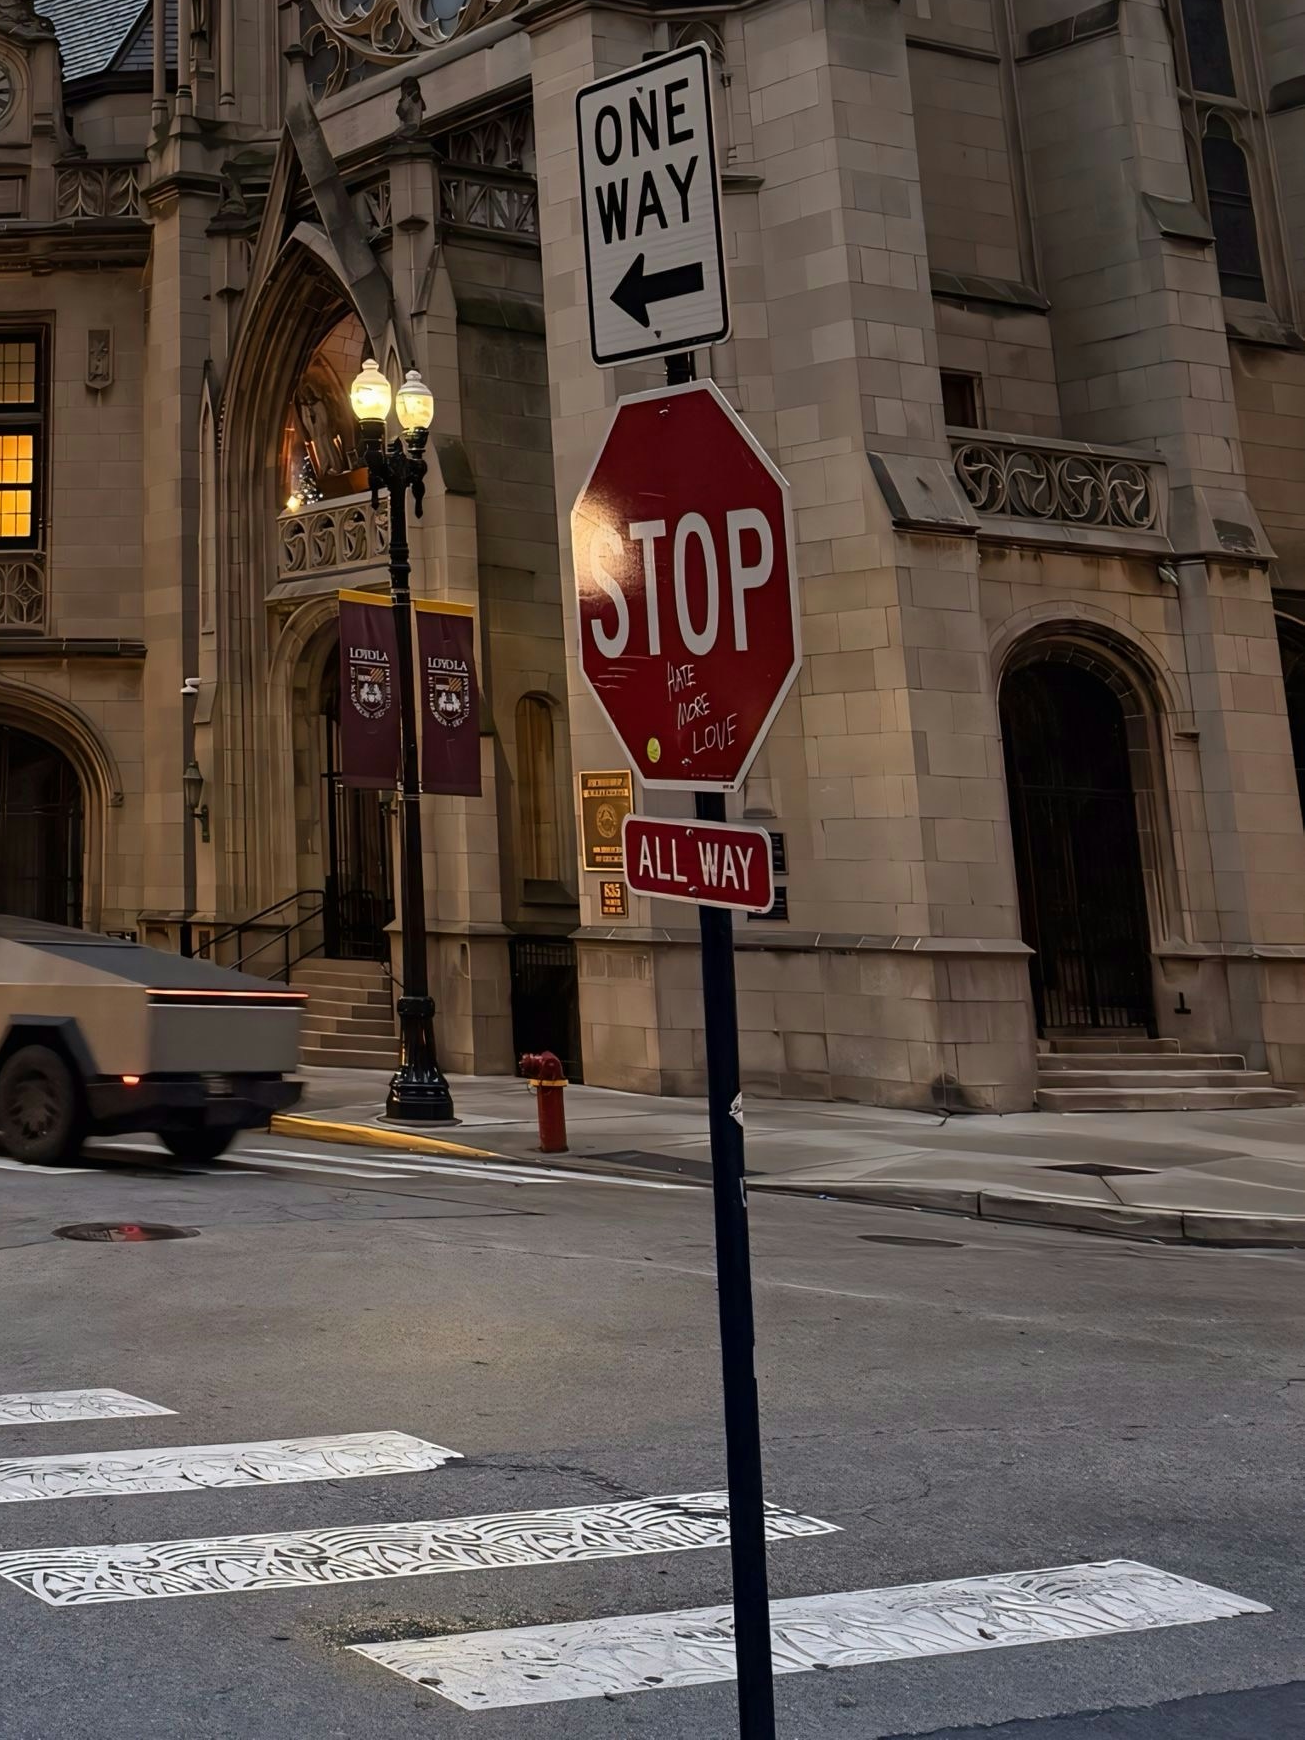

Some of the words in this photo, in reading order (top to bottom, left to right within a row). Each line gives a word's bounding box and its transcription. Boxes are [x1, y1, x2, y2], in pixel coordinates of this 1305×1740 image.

[595, 77, 694, 166] ONE
[595, 156, 698, 245] WAY
[590, 508, 774, 659] STOP
[349, 647, 389, 662] LOYOLA
[427, 657, 468, 672] LOYOLA
[667, 661, 696, 702] HATE
[677, 692, 710, 730] MORE
[693, 713, 738, 754] LOVE
[639, 835, 687, 882] ALL
[698, 841, 753, 891] WAY
